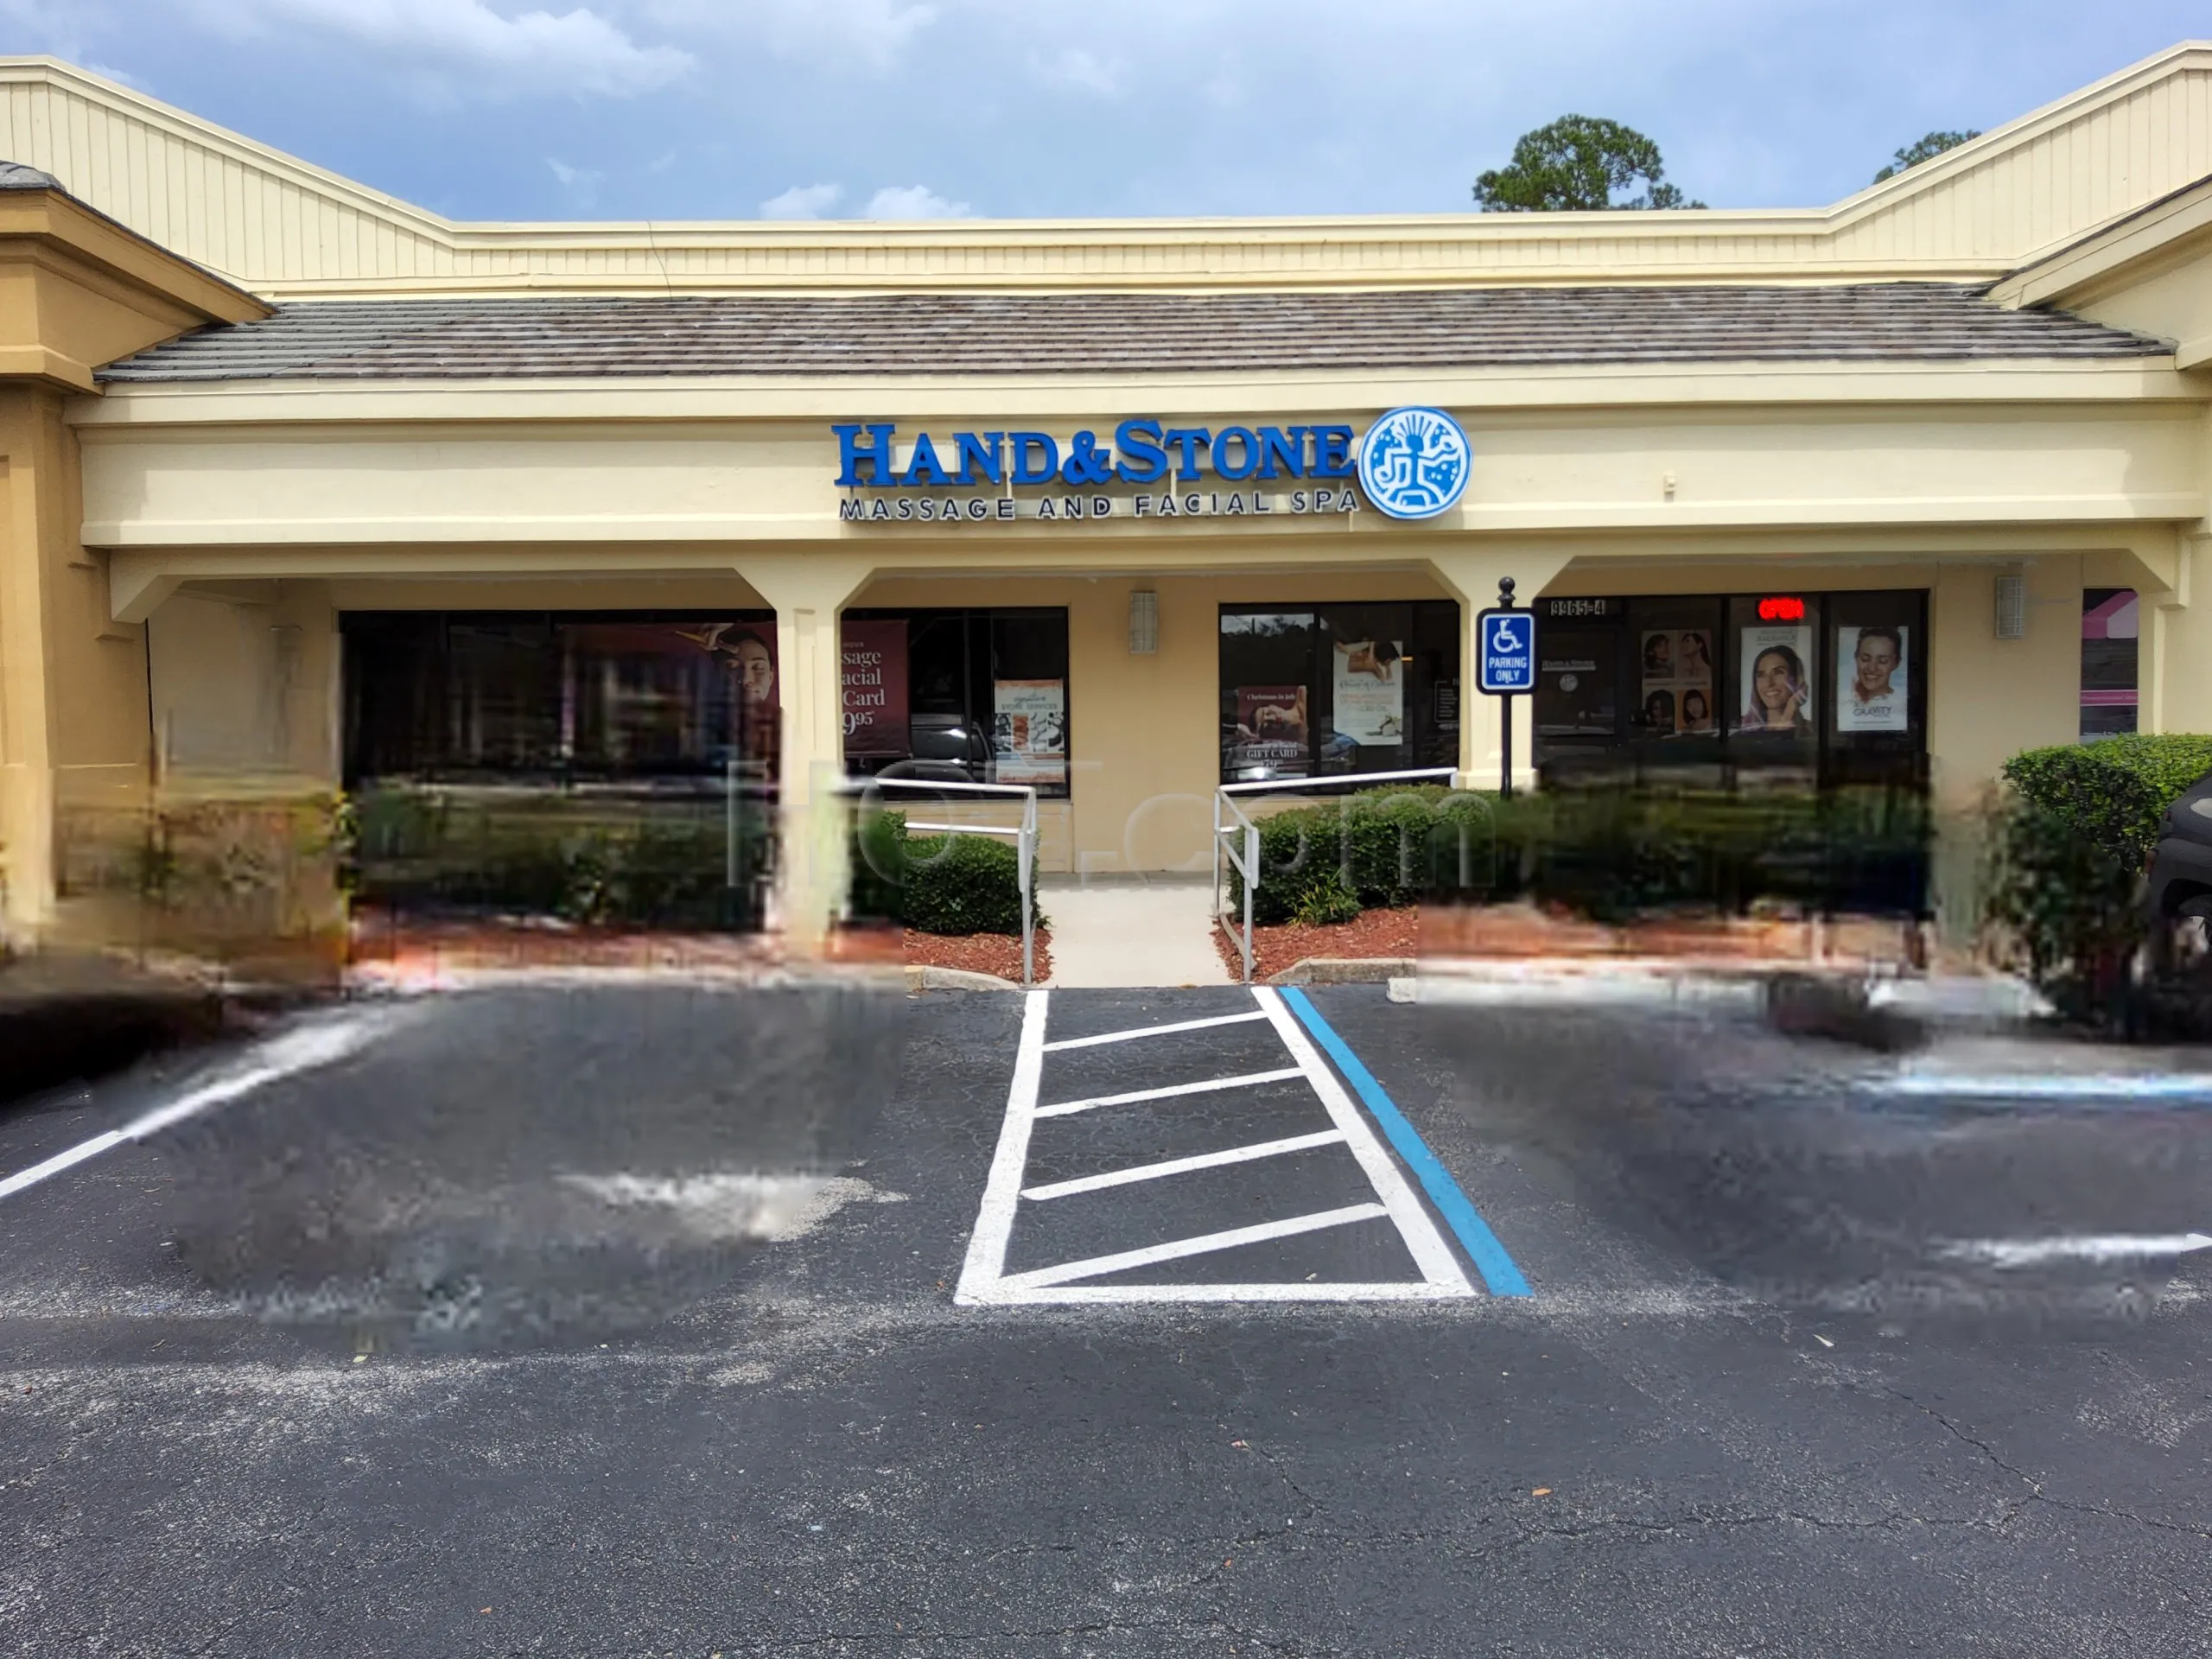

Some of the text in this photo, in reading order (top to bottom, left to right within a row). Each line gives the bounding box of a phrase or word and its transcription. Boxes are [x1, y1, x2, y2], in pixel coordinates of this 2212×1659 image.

[838, 488, 1361, 523] MASSAGE AND FACIAL SPA
[842, 652, 881, 667] sage
[1489, 657, 1528, 669] PARKING
[842, 668, 881, 685] acial
[1495, 670, 1521, 682] ONLY
[842, 689, 886, 706] Card
[1246, 749, 1298, 759] GIFT CARD
